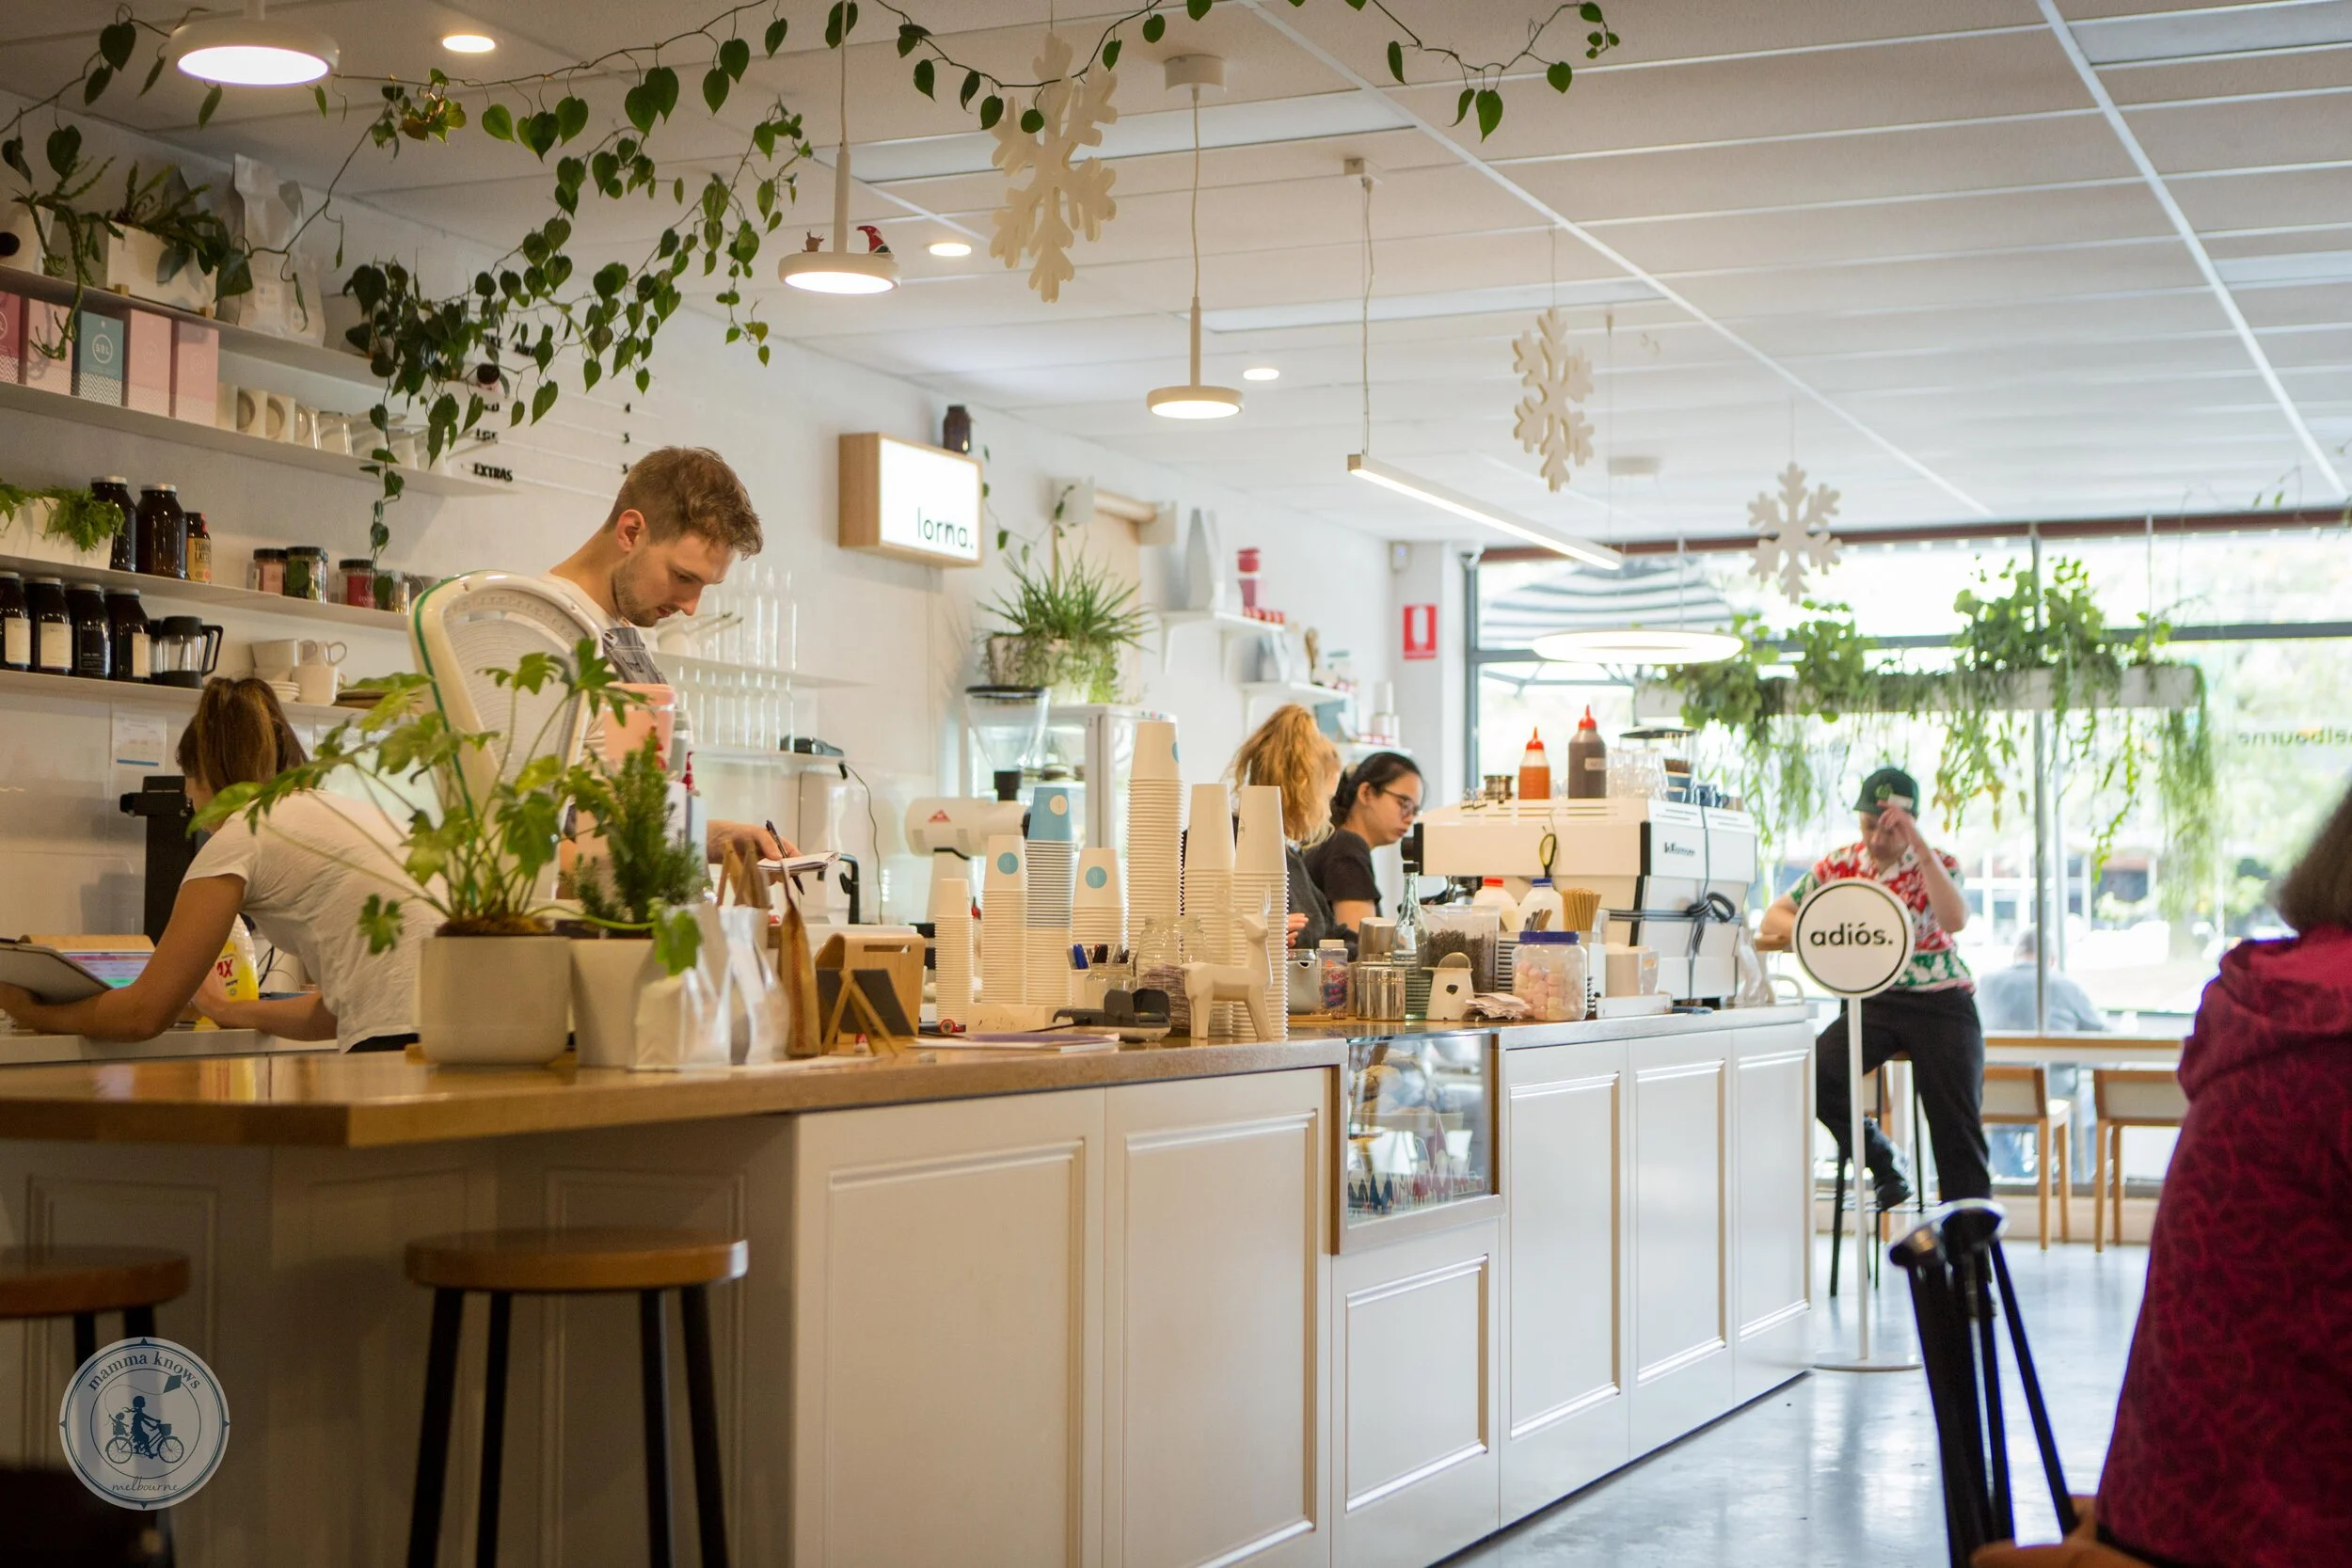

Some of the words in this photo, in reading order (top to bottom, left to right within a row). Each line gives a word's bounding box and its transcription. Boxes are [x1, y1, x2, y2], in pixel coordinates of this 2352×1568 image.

[473, 461, 514, 483] EXTRAS
[917, 506, 974, 549] lorna.
[1810, 922, 1894, 946] adiós.
